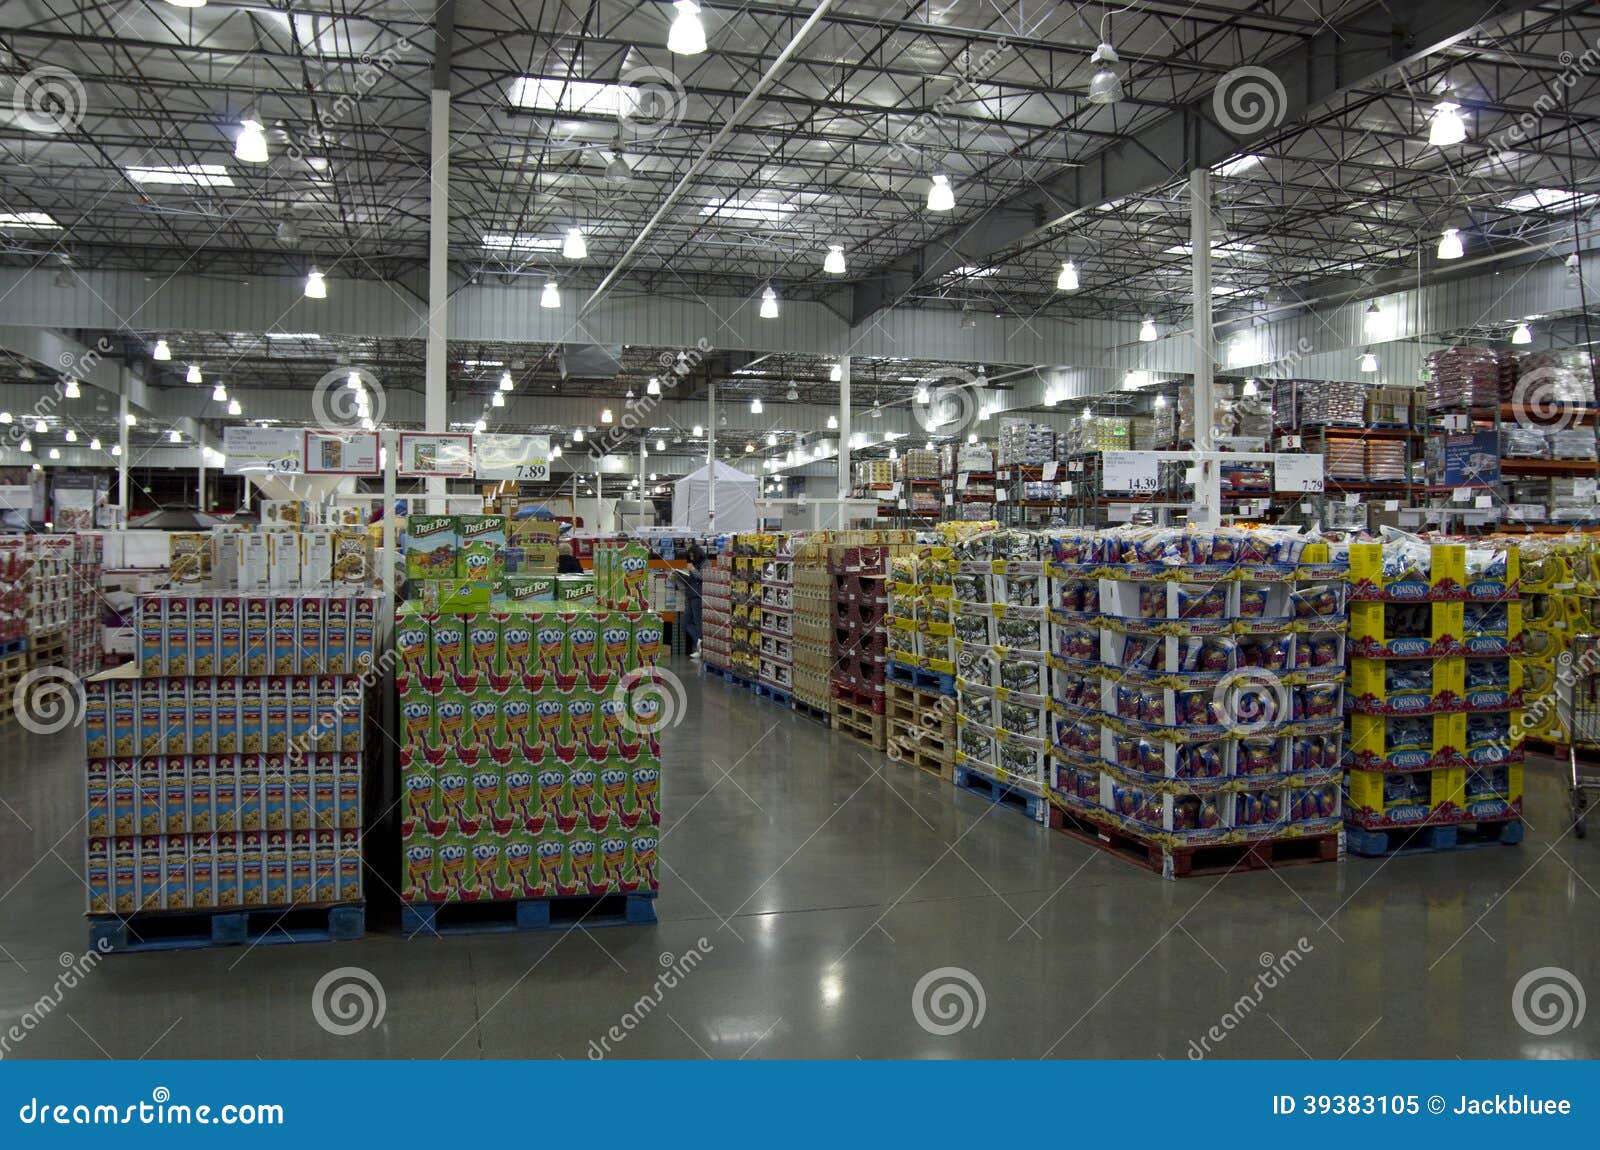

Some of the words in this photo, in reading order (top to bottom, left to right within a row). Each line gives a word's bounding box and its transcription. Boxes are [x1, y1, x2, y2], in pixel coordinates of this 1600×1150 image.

[1452, 415, 1458, 428] 1
[1287, 437, 1294, 447] 3
[515, 465, 546, 478] 7.89
[1072, 462, 1078, 470] 7
[1128, 478, 1157, 490] 14.39
[1302, 480, 1323, 490] 7.79
[415, 522, 434, 534] TREE
[464, 522, 483, 534] TREE
[484, 519, 500, 529] TOP
[514, 586, 533, 597] TREE
[533, 582, 549, 591] TOP
[566, 588, 584, 599] TREE
